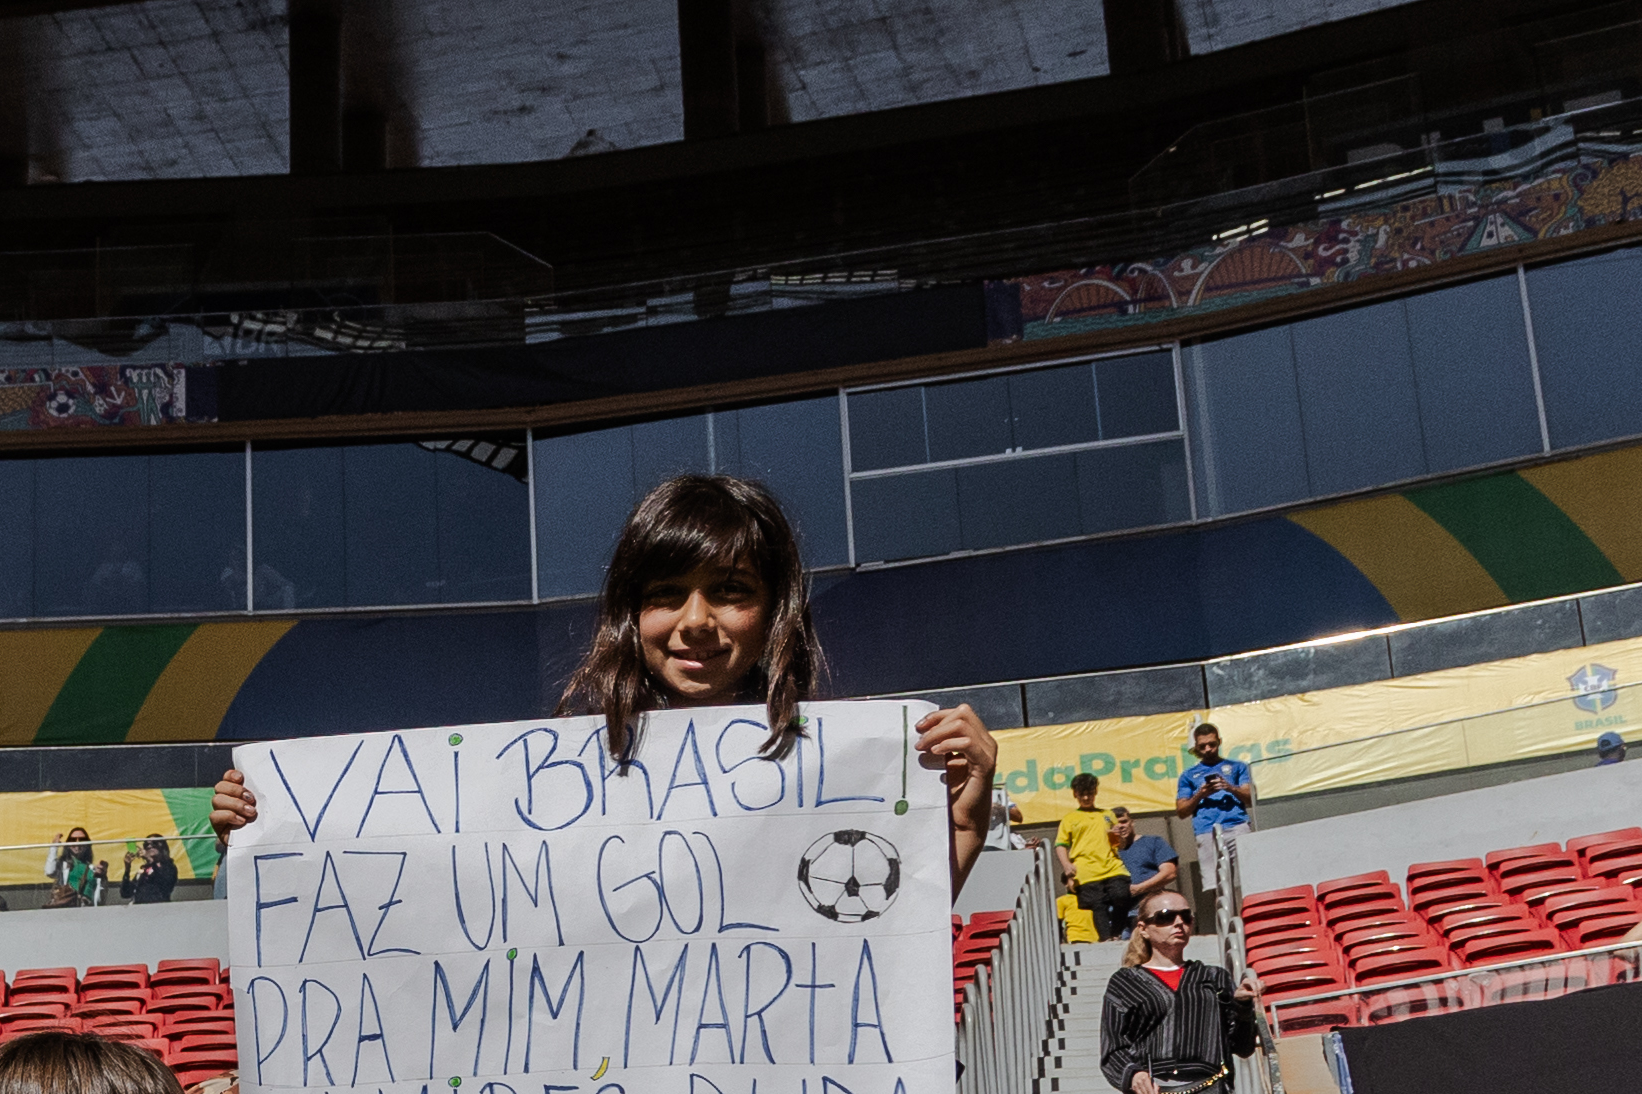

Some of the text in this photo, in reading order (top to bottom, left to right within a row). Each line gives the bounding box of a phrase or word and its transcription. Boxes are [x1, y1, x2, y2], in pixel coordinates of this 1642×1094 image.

[1574, 714, 1628, 731] BRASIL
[254, 829, 780, 968] FAZ UM GOL
[246, 971, 396, 1087] PRA
